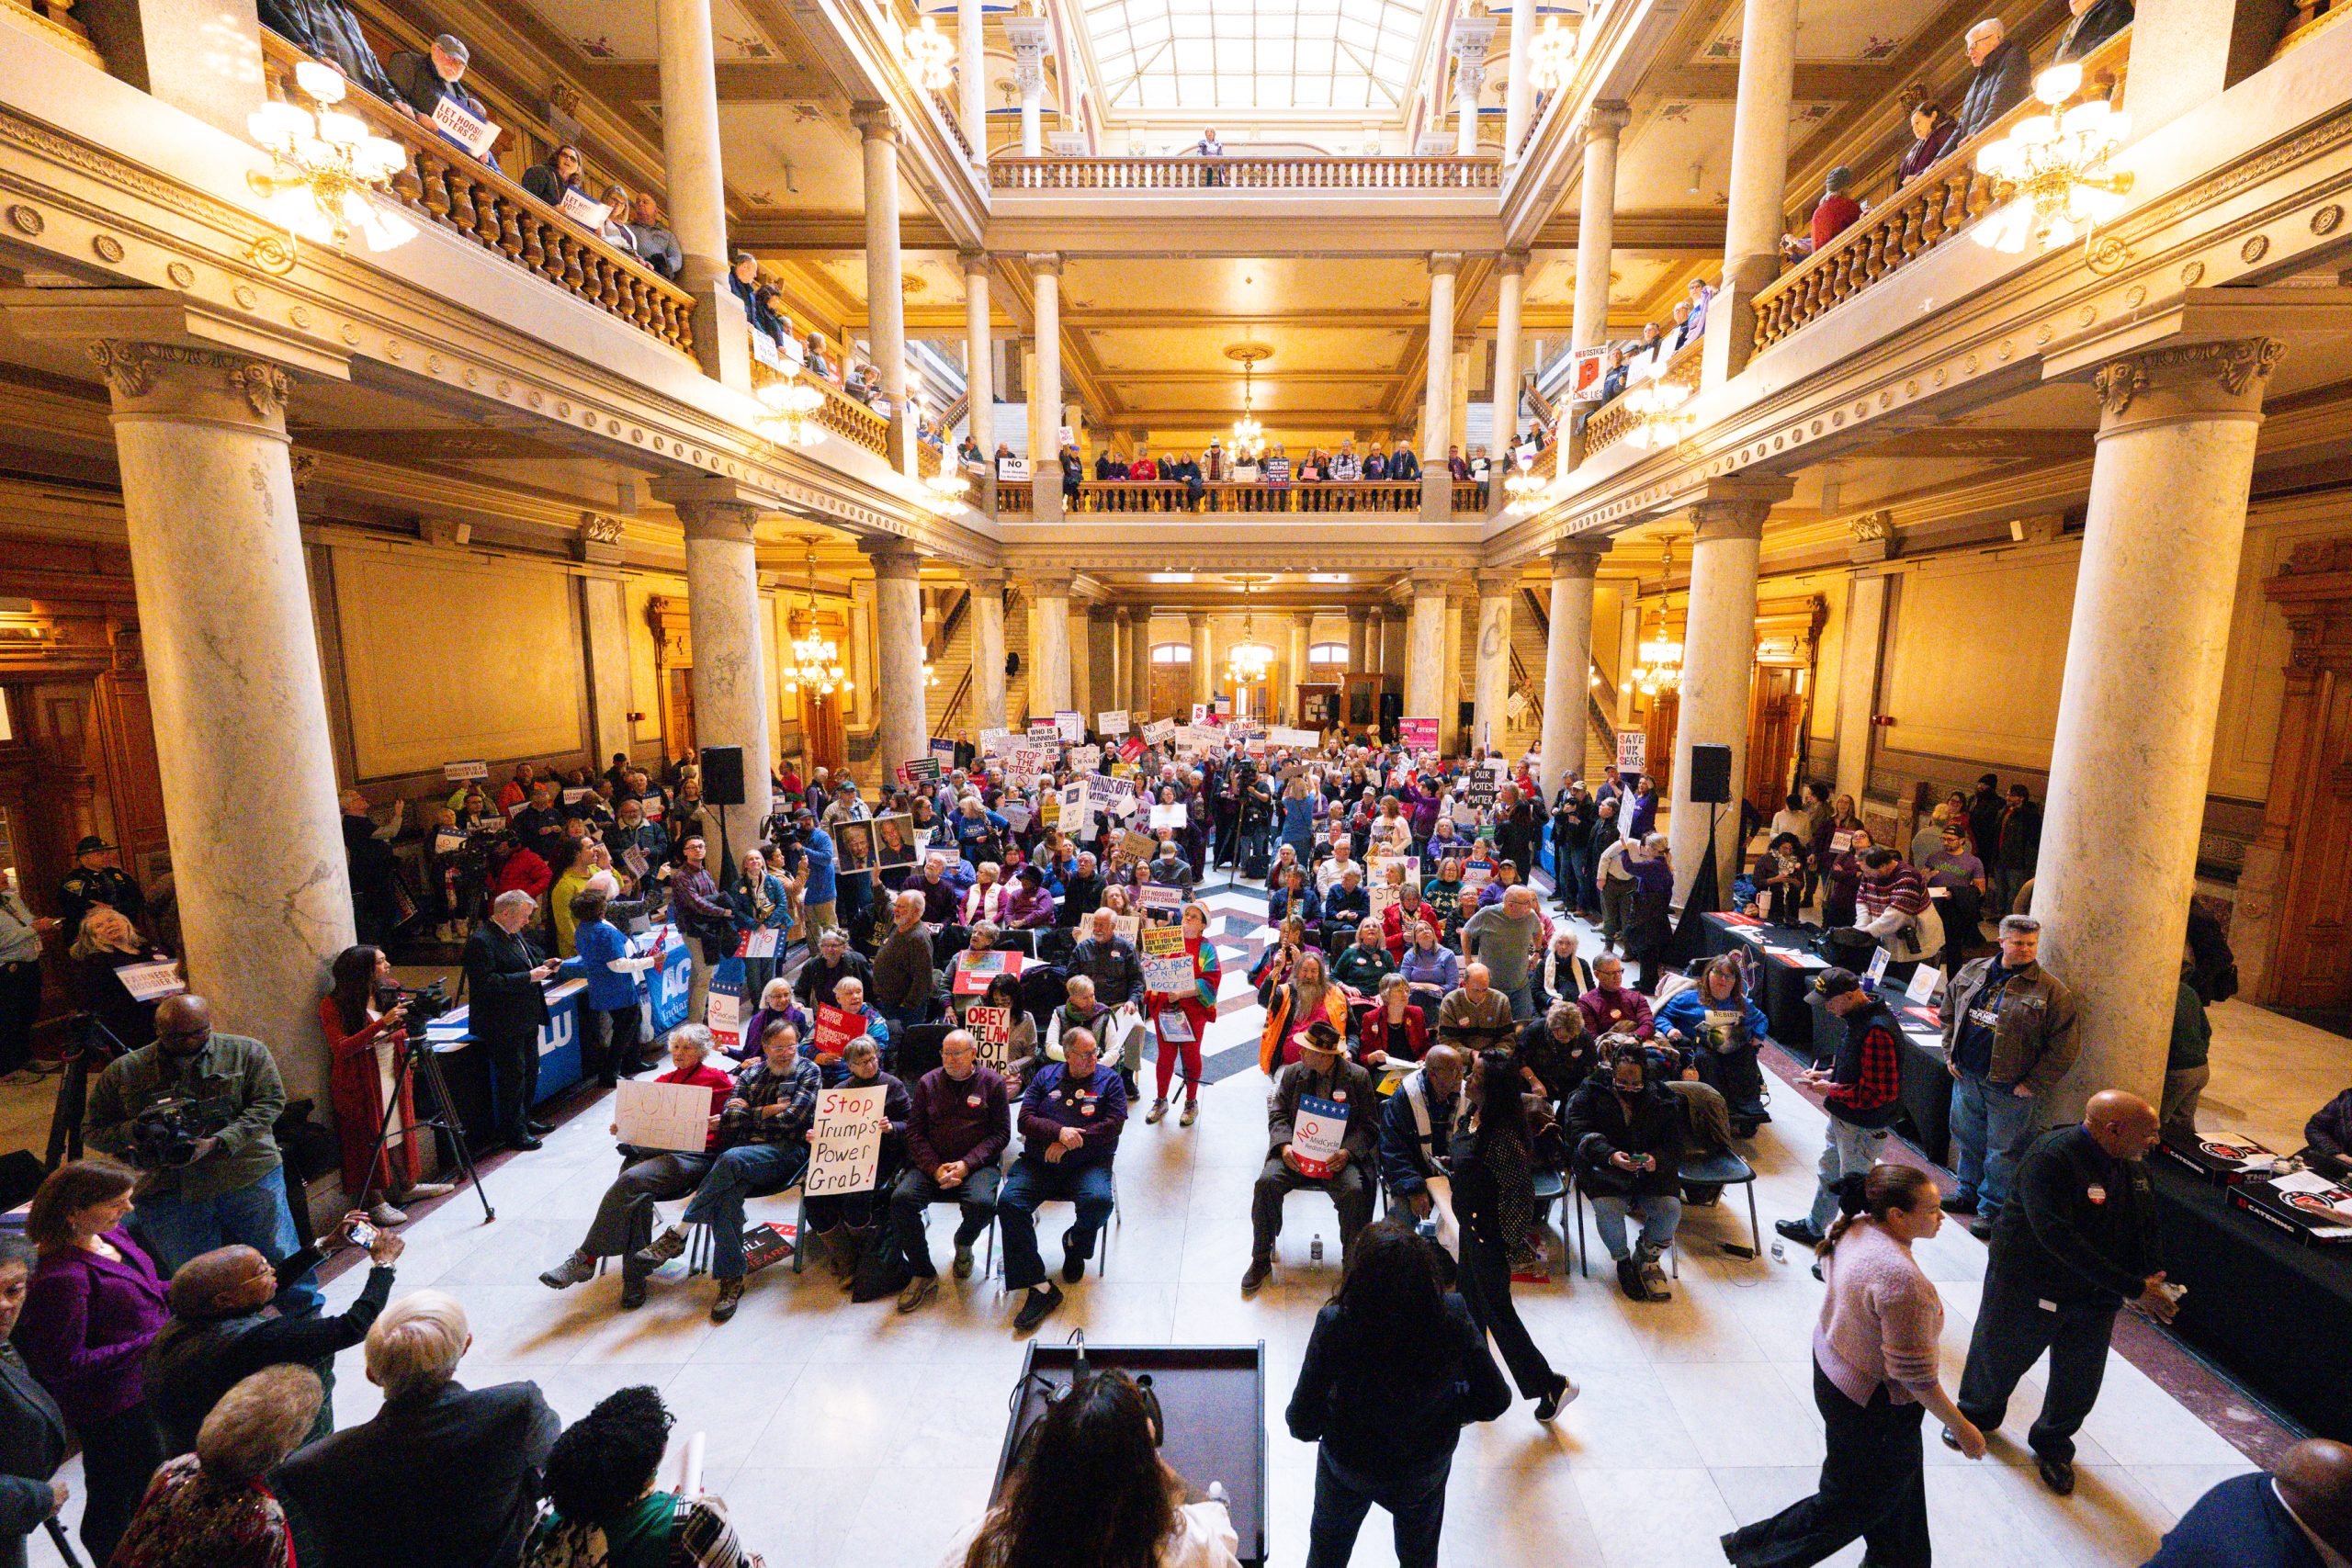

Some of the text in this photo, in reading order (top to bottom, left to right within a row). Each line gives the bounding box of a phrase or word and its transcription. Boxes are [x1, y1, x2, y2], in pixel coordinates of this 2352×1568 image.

[439, 103, 456, 118] LET
[436, 111, 468, 137] VOTERS
[565, 194, 578, 206] LET
[1242, 721, 1256, 729] NOT
[1620, 735, 1645, 744] SAVE
[1016, 750, 1041, 759] STOP
[1620, 745, 1638, 755] OUR
[1017, 759, 1035, 767] THE
[1620, 756, 1644, 766] SEATS
[1475, 770, 1490, 779] OUR
[1091, 776, 1117, 795] HANDS
[1470, 782, 1493, 791] VOTES
[1089, 792, 1108, 803] VOTING
[1468, 795, 1492, 806] MATTER
[1160, 897, 1181, 905] CHOOSE
[1144, 931, 1159, 940] WHY
[1159, 930, 1182, 938] CHEAT?
[1171, 958, 1193, 969] HACKS
[124, 970, 170, 984] FAIRNESS
[662, 958, 691, 1006] AC
[130, 977, 172, 991] HOOSIER
[710, 999, 722, 1018] NO
[820, 1007, 843, 1020] HOOSIERS
[967, 1008, 1006, 1026] OBEY
[537, 1010, 572, 1056] LU
[967, 1025, 1009, 1043] THE LAW
[823, 1094, 873, 1117] Stop
[818, 1117, 878, 1140] Trump's
[1296, 1122, 1318, 1143] NO
[1309, 1136, 1339, 1147] MidCycle
[816, 1143, 871, 1163] Power
[2169, 1151, 2205, 1174] CATERING
[2247, 1204, 2294, 1233] CATERING
